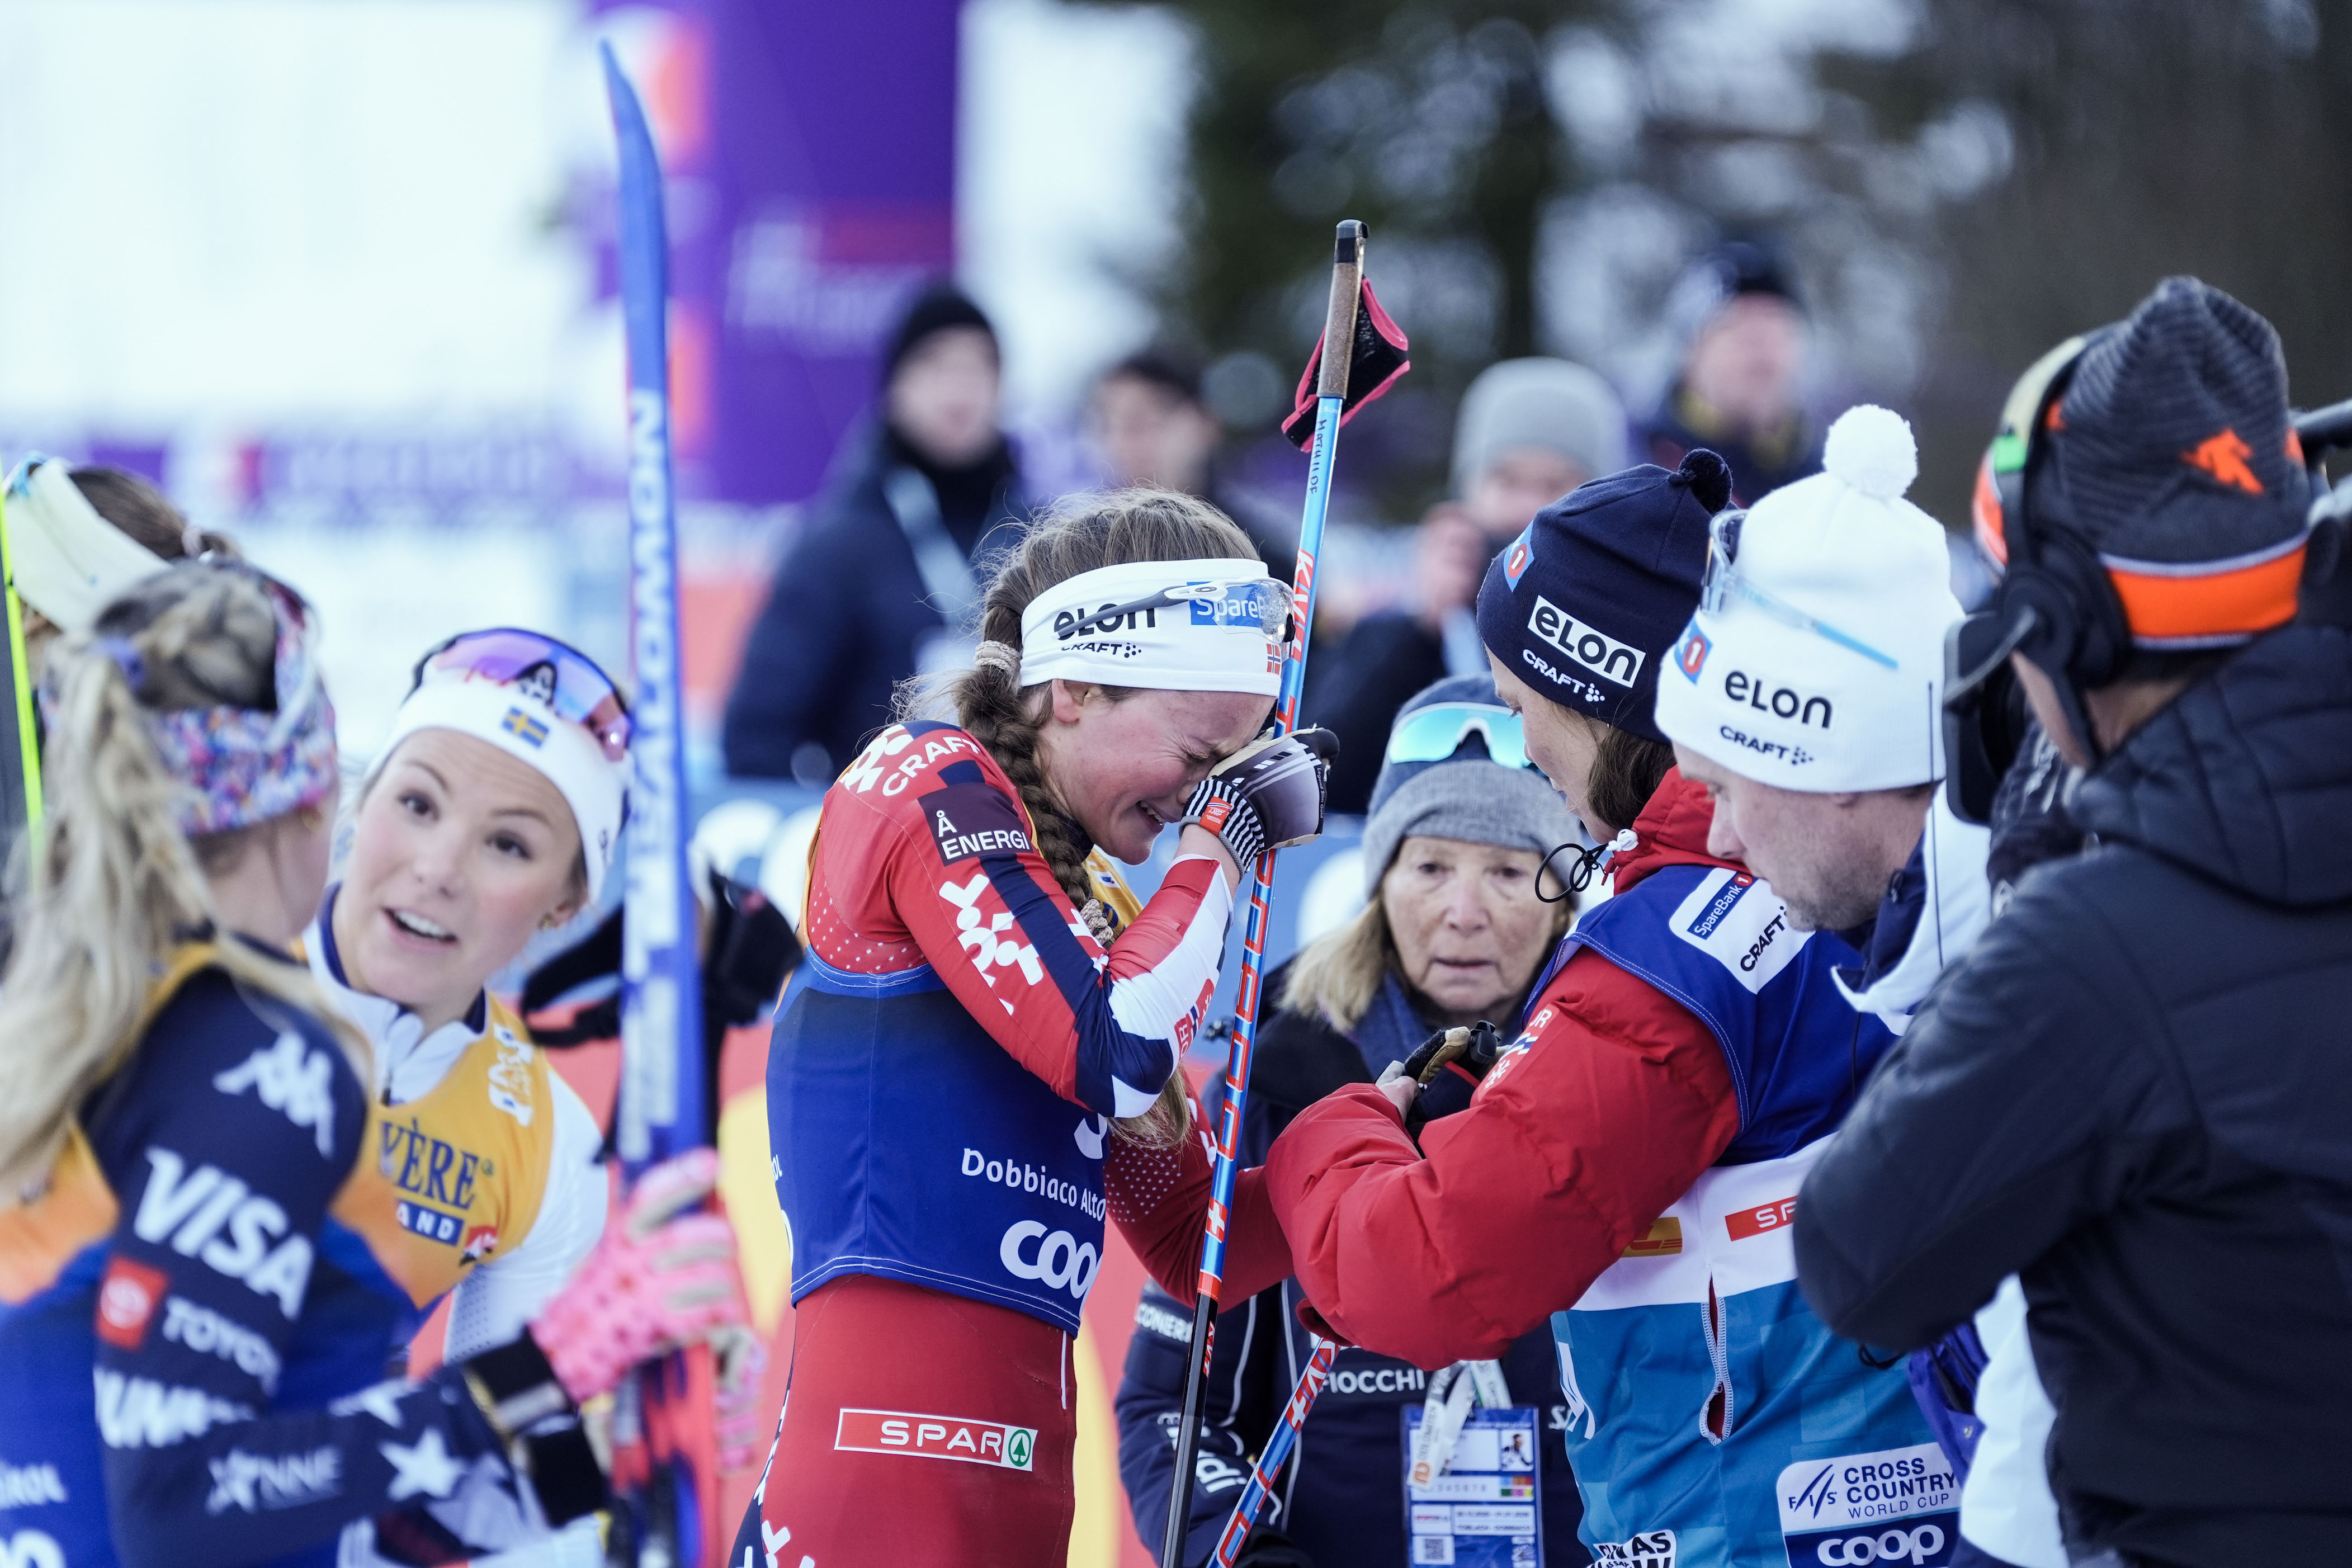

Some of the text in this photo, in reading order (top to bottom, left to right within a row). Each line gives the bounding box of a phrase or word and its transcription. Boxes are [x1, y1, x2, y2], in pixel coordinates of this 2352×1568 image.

[1522, 648, 1586, 695] CRAFT
[1720, 725, 1788, 761] CRAFT
[882, 735, 981, 796] CRAFT
[937, 810, 957, 837] Å
[941, 830, 1030, 860] ENERGI
[1694, 885, 1742, 936] SpareBank
[1740, 914, 1785, 972] CRAFT
[961, 1147, 1106, 1222] Dobbiaco Alto
[134, 1145, 315, 1321] VISA
[162, 1295, 280, 1396] TOYOT
[880, 1421, 1002, 1456] SPAR
[1844, 1457, 1925, 1485] CROSS
[1846, 1471, 1955, 1504] COUNTRY
[1848, 1493, 1950, 1519] WORLD CUP
[1817, 1524, 1945, 1567] coop
